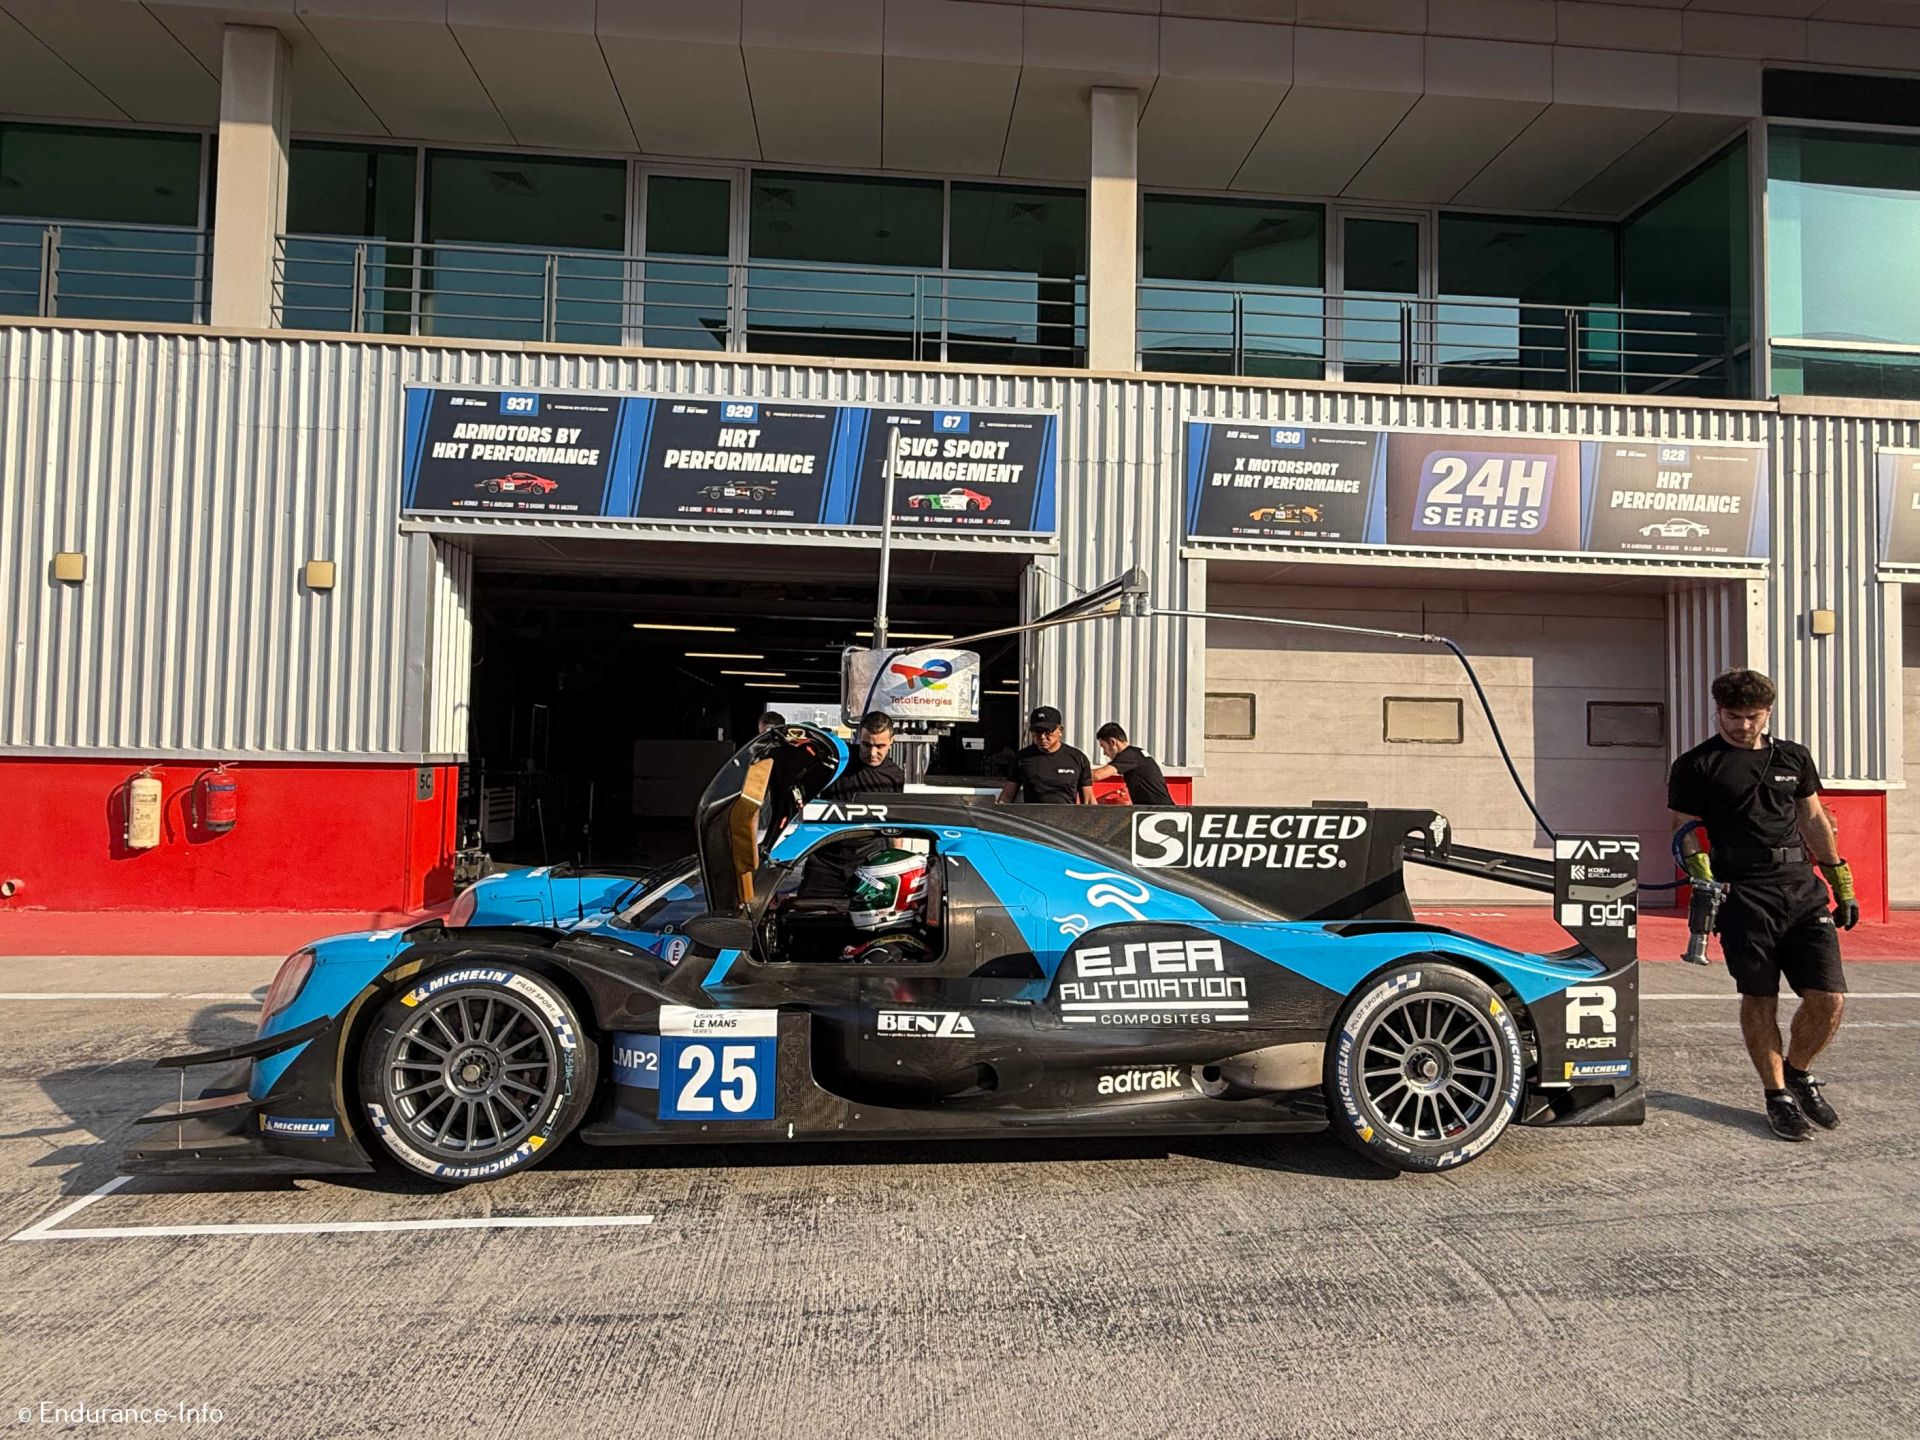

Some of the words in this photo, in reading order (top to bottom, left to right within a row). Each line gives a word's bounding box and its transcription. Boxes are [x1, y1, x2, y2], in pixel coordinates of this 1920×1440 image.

[506, 397, 534, 411] 931
[726, 404, 754, 418] 929
[942, 415, 962, 428] 67
[453, 423, 552, 443] ARMOTORS
[556, 428, 581, 444] BY
[717, 429, 760, 448] HRT
[1275, 430, 1301, 444] 930
[432, 442, 465, 460] HRT
[471, 444, 600, 466] PERFORMANCE
[899, 437, 939, 457] SVC
[943, 439, 1009, 461] SPORT
[1661, 448, 1687, 462] 928
[664, 450, 815, 475] PERFORMANCE
[1234, 457, 1245, 471] X
[1248, 458, 1339, 476] MOTORSPORT
[1212, 473, 1229, 487] BY
[1233, 474, 1260, 488] HRT
[1263, 475, 1360, 494] PERFORMANCE
[1426, 457, 1548, 507] 24H
[1656, 471, 1693, 490] HRT
[1610, 490, 1741, 514] PERFORMANCE
[1422, 505, 1540, 529] SERIES
[890, 695, 953, 707] TotalEnergies
[420, 774, 432, 789] 5C
[820, 804, 888, 821] APR
[1574, 840, 1640, 860] APR
[1589, 898, 1636, 926] gdr
[672, 950, 680, 961] E
[429, 968, 508, 991] MICHELIN
[515, 980, 535, 996] PILOT
[535, 993, 556, 1014] SPORT
[1059, 977, 1247, 1001] AUTOMATION
[1100, 1014, 1211, 1025] COMPOSITES
[1565, 985, 1617, 1034] R
[693, 1019, 706, 1028] LE
[708, 1019, 738, 1028] MANS
[877, 1010, 976, 1038] BENZA
[1338, 1038, 1359, 1116] MICHELIN
[1350, 1009, 1365, 1029] PILOT
[1364, 990, 1384, 1009] SPORT
[1565, 1037, 1617, 1050] RACER
[612, 1044, 658, 1071] LMP2
[1504, 1025, 1521, 1102] MICHELIN
[676, 1044, 758, 1113] 25
[1580, 1064, 1628, 1074] MICHELIN
[1097, 1066, 1181, 1095] adtrak
[273, 1121, 330, 1132] MICHELIN
[442, 1155, 520, 1177] MICHELIN
